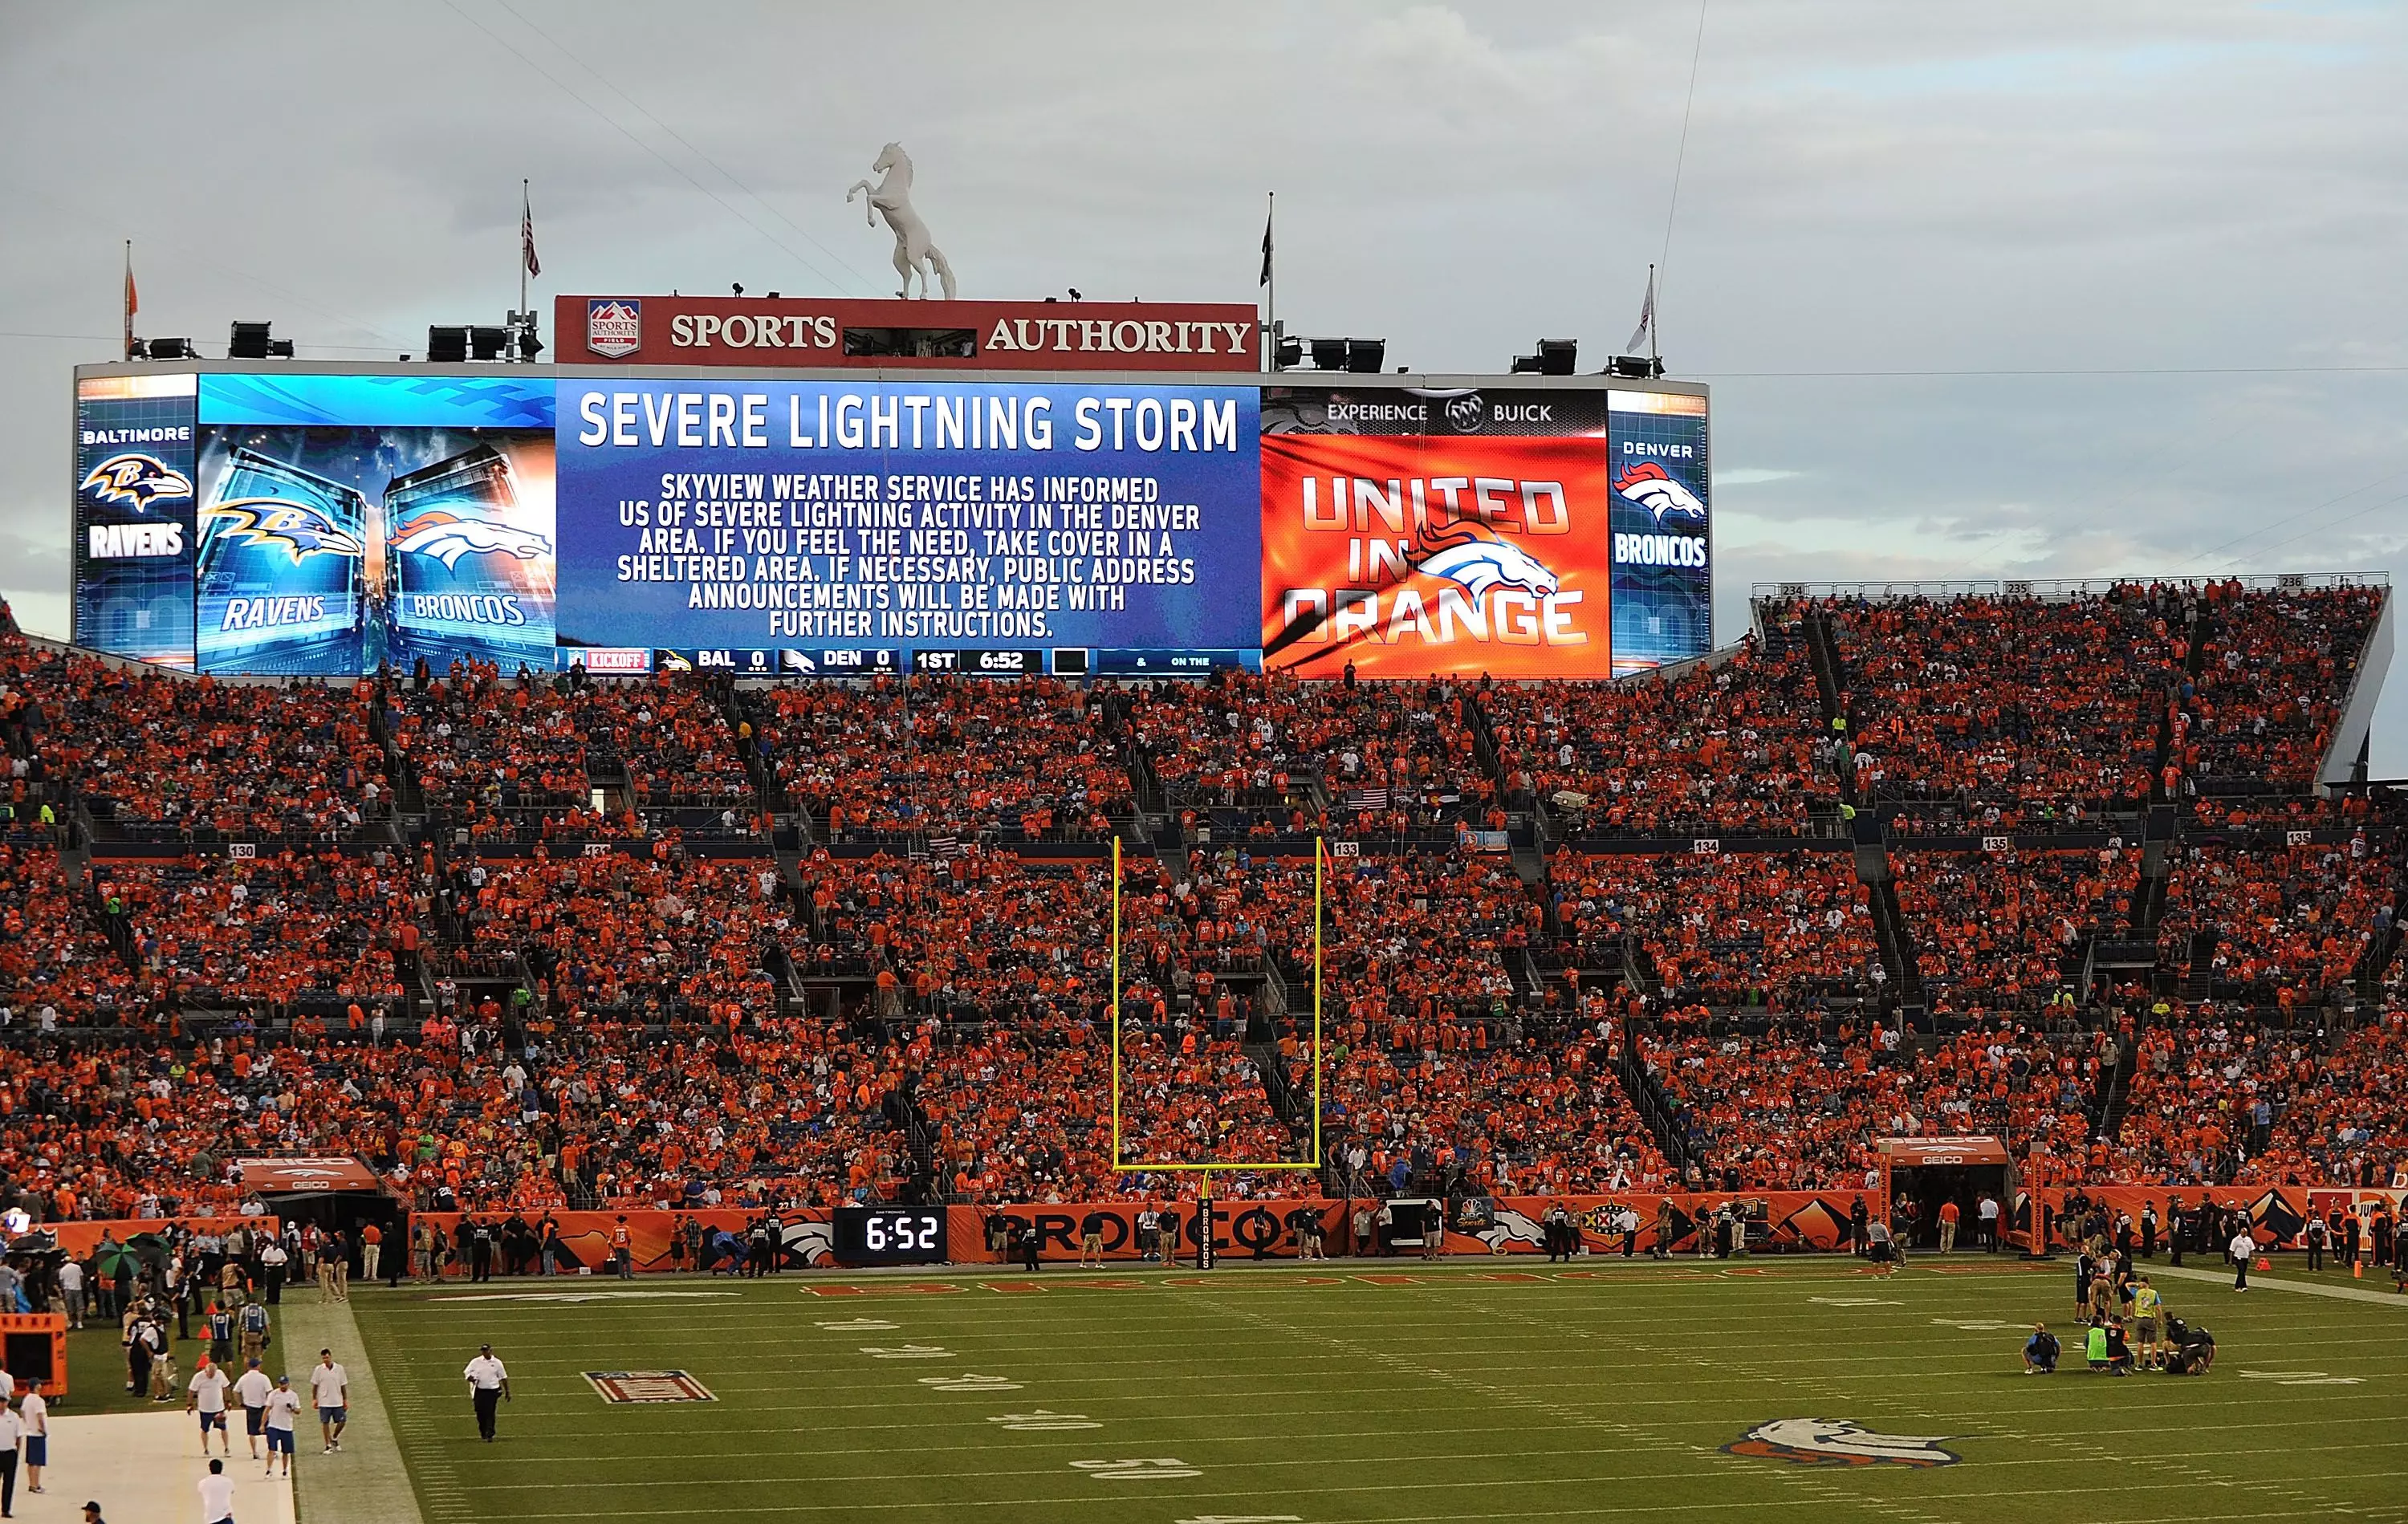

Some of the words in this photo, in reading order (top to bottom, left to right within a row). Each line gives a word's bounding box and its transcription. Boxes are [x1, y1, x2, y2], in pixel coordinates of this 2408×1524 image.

[592, 321, 637, 330] SPORTS
[671, 315, 837, 348] SPORTS
[985, 318, 1252, 354] AUTHORITY
[1328, 404, 1427, 421] EXPERIENCE
[1495, 405, 1552, 422] BUICK
[579, 392, 768, 448] SEVERE
[790, 394, 1053, 451] LIGHTNING
[1074, 396, 1238, 453] STORM
[83, 426, 190, 445] BALTIMORE
[1623, 441, 1693, 459] DENVER
[661, 473, 764, 500] SKYVIEW
[772, 474, 879, 501] WEATHER
[887, 475, 982, 502] SERVICE
[990, 476, 1035, 502] HAS
[1043, 477, 1158, 503] INFORMED
[1302, 476, 1571, 535] UNITED
[620, 500, 649, 526] US
[657, 501, 687, 526] OF
[694, 501, 782, 527] SEVERE
[791, 502, 912, 528] LIGHTNING
[920, 503, 1022, 529] ACTIVITY
[1030, 503, 1051, 530] IN
[1060, 504, 1102, 530] THE
[1112, 504, 1200, 530] DENVER
[89, 523, 183, 559] RAVENS
[639, 528, 706, 554] AREA.
[714, 528, 735, 554] IF
[742, 529, 787, 555] YOU
[796, 529, 850, 555] FEEL
[858, 529, 901, 555] THE
[909, 530, 976, 559] NEED,
[983, 530, 1039, 556] TAKE
[1047, 530, 1120, 557] COVER
[1129, 531, 1151, 557] IN
[1159, 531, 1173, 557] A
[1614, 533, 1706, 568] BRONCOS
[1348, 538, 1409, 583] IN
[617, 555, 746, 581] SHELTERED
[754, 556, 820, 582] AREA.
[829, 556, 850, 582] IF
[858, 557, 995, 586] NECESSARY,
[1004, 558, 1084, 583] PUBLIC
[1091, 559, 1195, 584] ADDRESS
[2008, 583, 2027, 593] 235
[2282, 577, 2301, 587] 236
[689, 583, 890, 610] ANNOUNCEMENTS
[897, 584, 952, 610] WILL
[961, 584, 989, 610] BE
[997, 585, 1060, 610] MADE
[1068, 585, 1125, 611] WITH
[1783, 586, 1802, 595] 234
[222, 595, 325, 631] RAVENS
[413, 595, 526, 626] BRONCOS
[1283, 588, 1589, 646] ORANGE
[770, 611, 872, 636] FURTHER
[881, 612, 1054, 637] INSTRUCTIONS.
[590, 652, 641, 668] KICKOFF
[698, 650, 735, 667] BAL
[751, 650, 764, 666] 0
[824, 649, 862, 666] DEN
[877, 650, 889, 665] 0
[917, 652, 955, 669] 1ST
[980, 652, 1023, 669] 6:52
[1137, 657, 1146, 667] &
[1171, 657, 1191, 667] ON
[1193, 656, 1210, 666] THE
[1562, 748, 1567, 756] 7
[1223, 774, 1234, 782] 58
[1984, 838, 2006, 850] 135
[2288, 832, 2310, 843] 135
[231, 846, 254, 857] 130
[1336, 843, 1358, 855] 133
[1696, 841, 1719, 852] 134
[1218, 900, 1228, 908] 63
[426, 1085, 434, 1093] 18
[1877, 1136, 1995, 1144] GEICO
[237, 1158, 354, 1166] GEICO
[1646, 1157, 1653, 1165] 18
[1922, 1156, 1963, 1164] GEICO
[292, 1181, 329, 1189] GEICO
[1457, 1217, 1486, 1228] Sports
[1460, 1212, 1485, 1220] NBC
[616, 1232, 624, 1241] 18
[866, 1217, 938, 1250] 6:52
[814, 1318, 901, 1331] 10
[917, 1373, 1024, 1392] 30
[986, 1409, 1104, 1430] 40
[1068, 1457, 1204, 1480] 50
